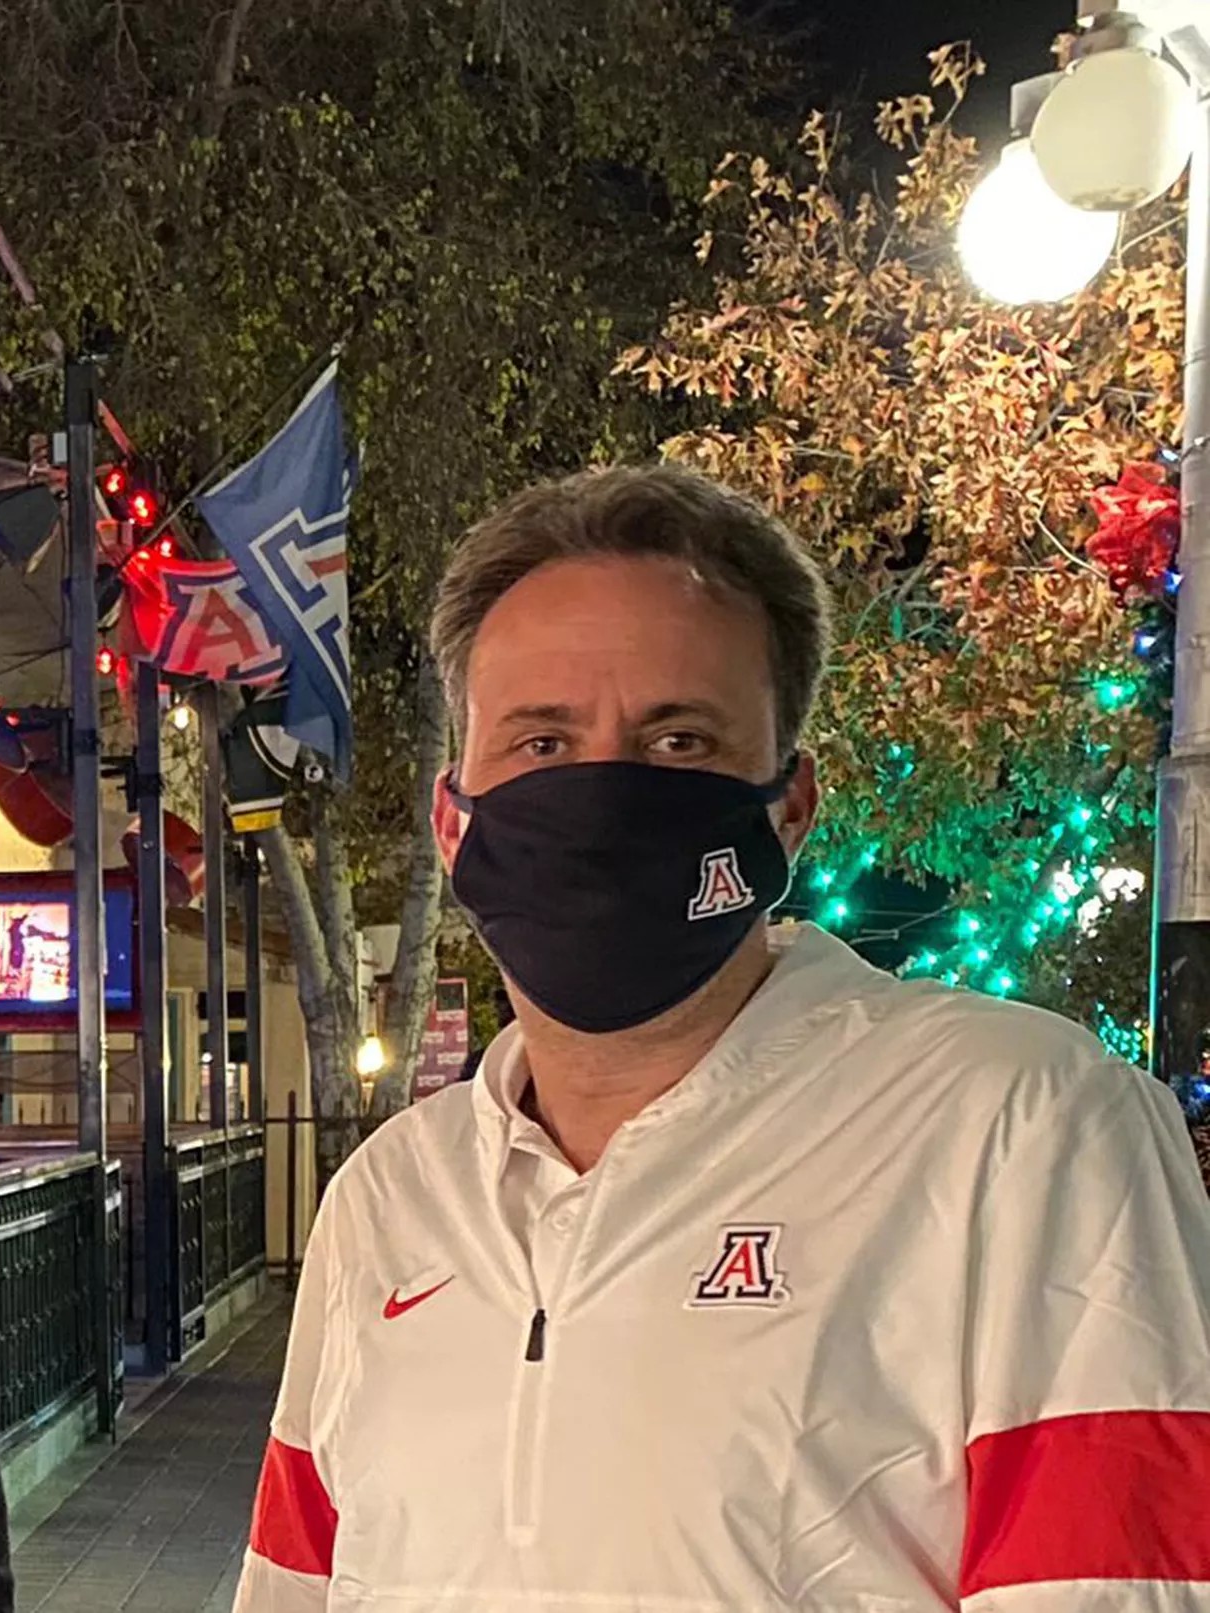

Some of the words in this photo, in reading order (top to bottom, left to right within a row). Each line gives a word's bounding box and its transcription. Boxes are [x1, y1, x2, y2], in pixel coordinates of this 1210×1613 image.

[160, 571, 284, 677] A
[690, 849, 753, 918] A
[693, 1230, 775, 1300] A
